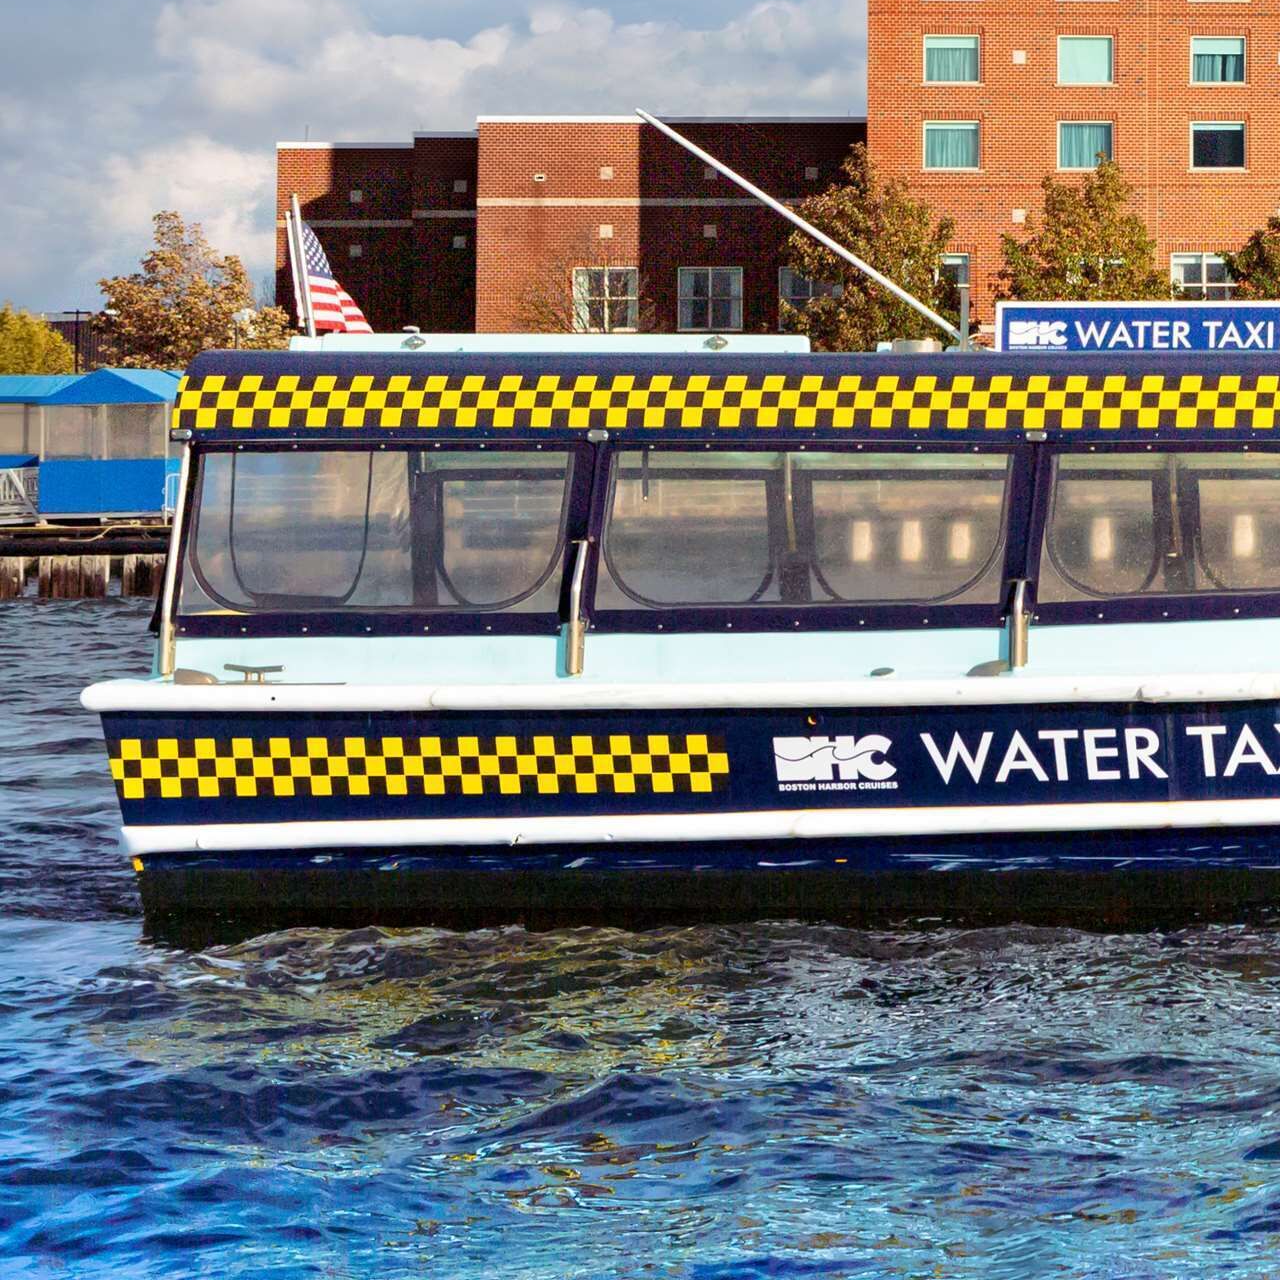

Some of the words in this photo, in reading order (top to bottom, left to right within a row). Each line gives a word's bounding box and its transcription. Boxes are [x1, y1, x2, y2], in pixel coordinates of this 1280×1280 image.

[1008, 320, 1068, 346] BHC
[1074, 320, 1192, 349] WATER
[1202, 320, 1274, 349] TAXI
[772, 734, 898, 782] BHC
[918, 727, 1169, 786] WATER
[778, 783, 817, 792] BOSTON
[818, 782, 857, 791] HARBOR
[858, 781, 899, 790] CRUISES
